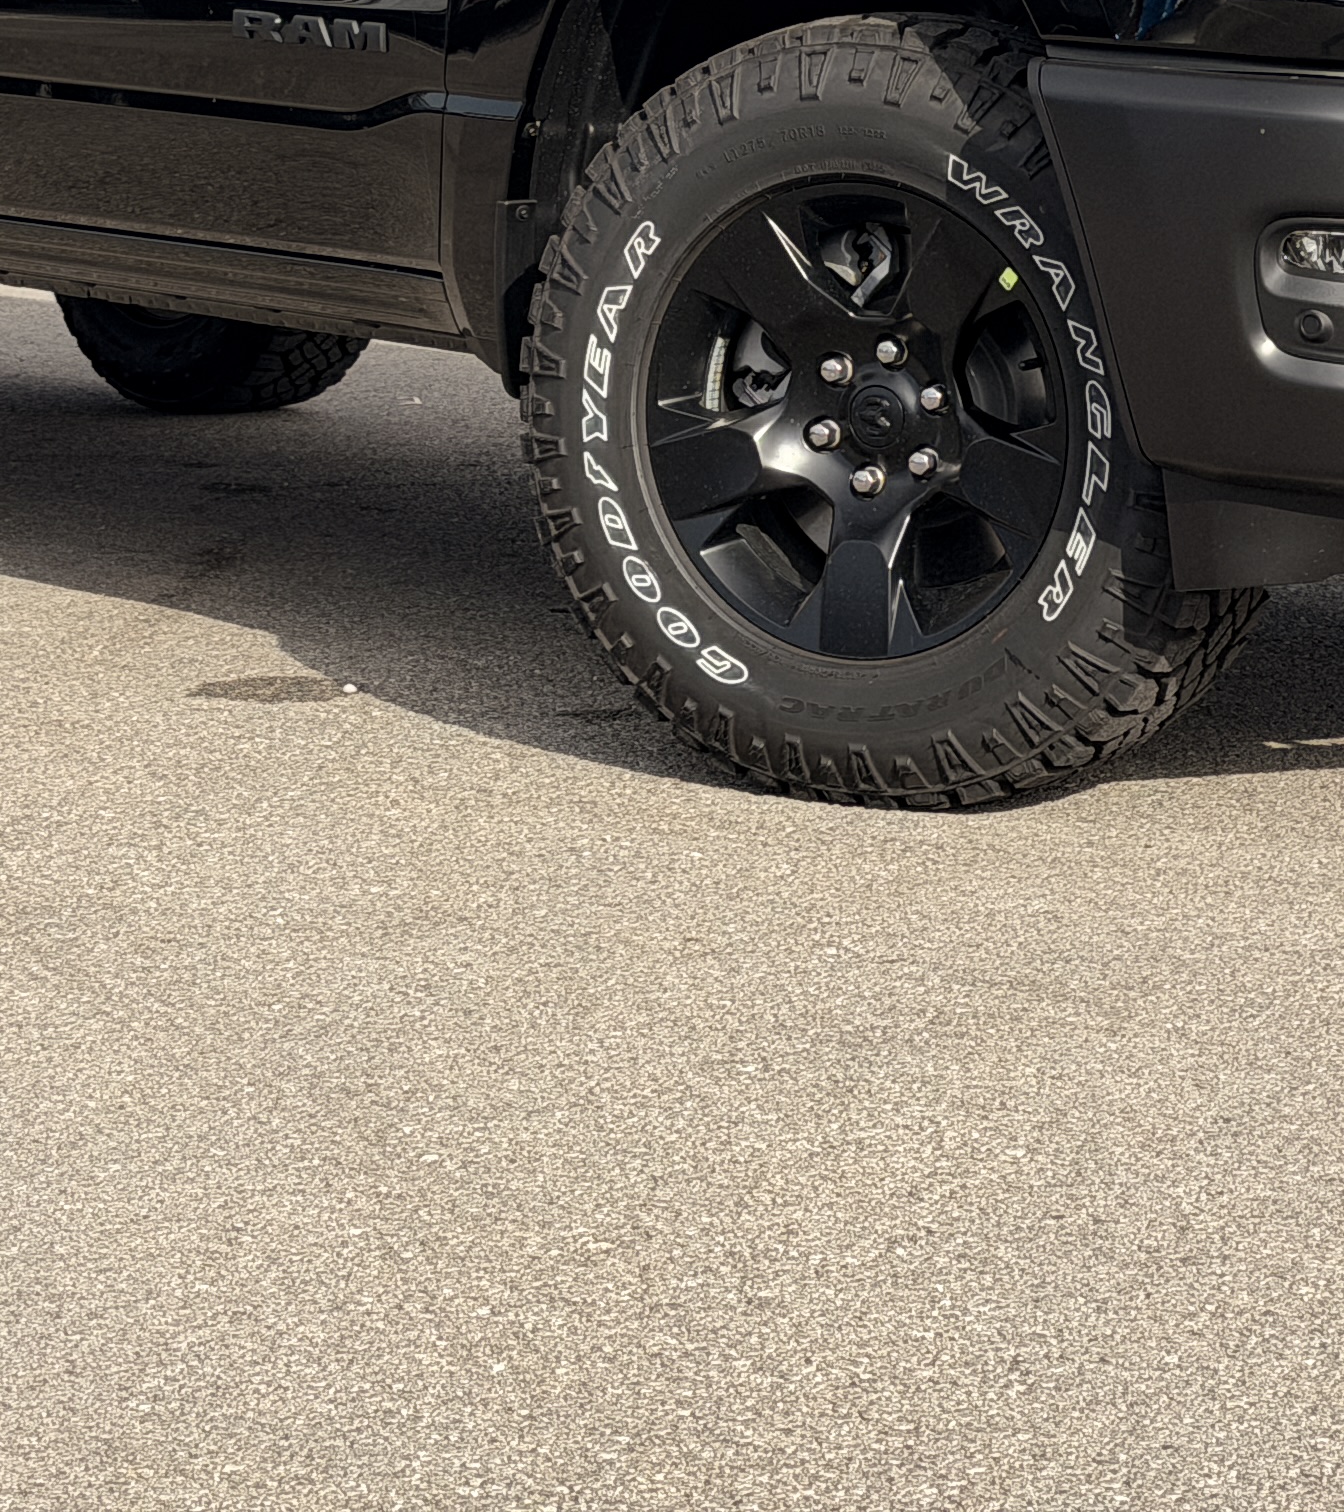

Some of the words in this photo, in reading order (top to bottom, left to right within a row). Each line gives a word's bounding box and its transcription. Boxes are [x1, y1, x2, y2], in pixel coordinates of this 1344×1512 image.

[232, 8, 390, 53] RAM
[579, 219, 749, 686] GOODYEAR
[944, 152, 1112, 624] WRANGLER
[777, 654, 1008, 723] DURATRAC
